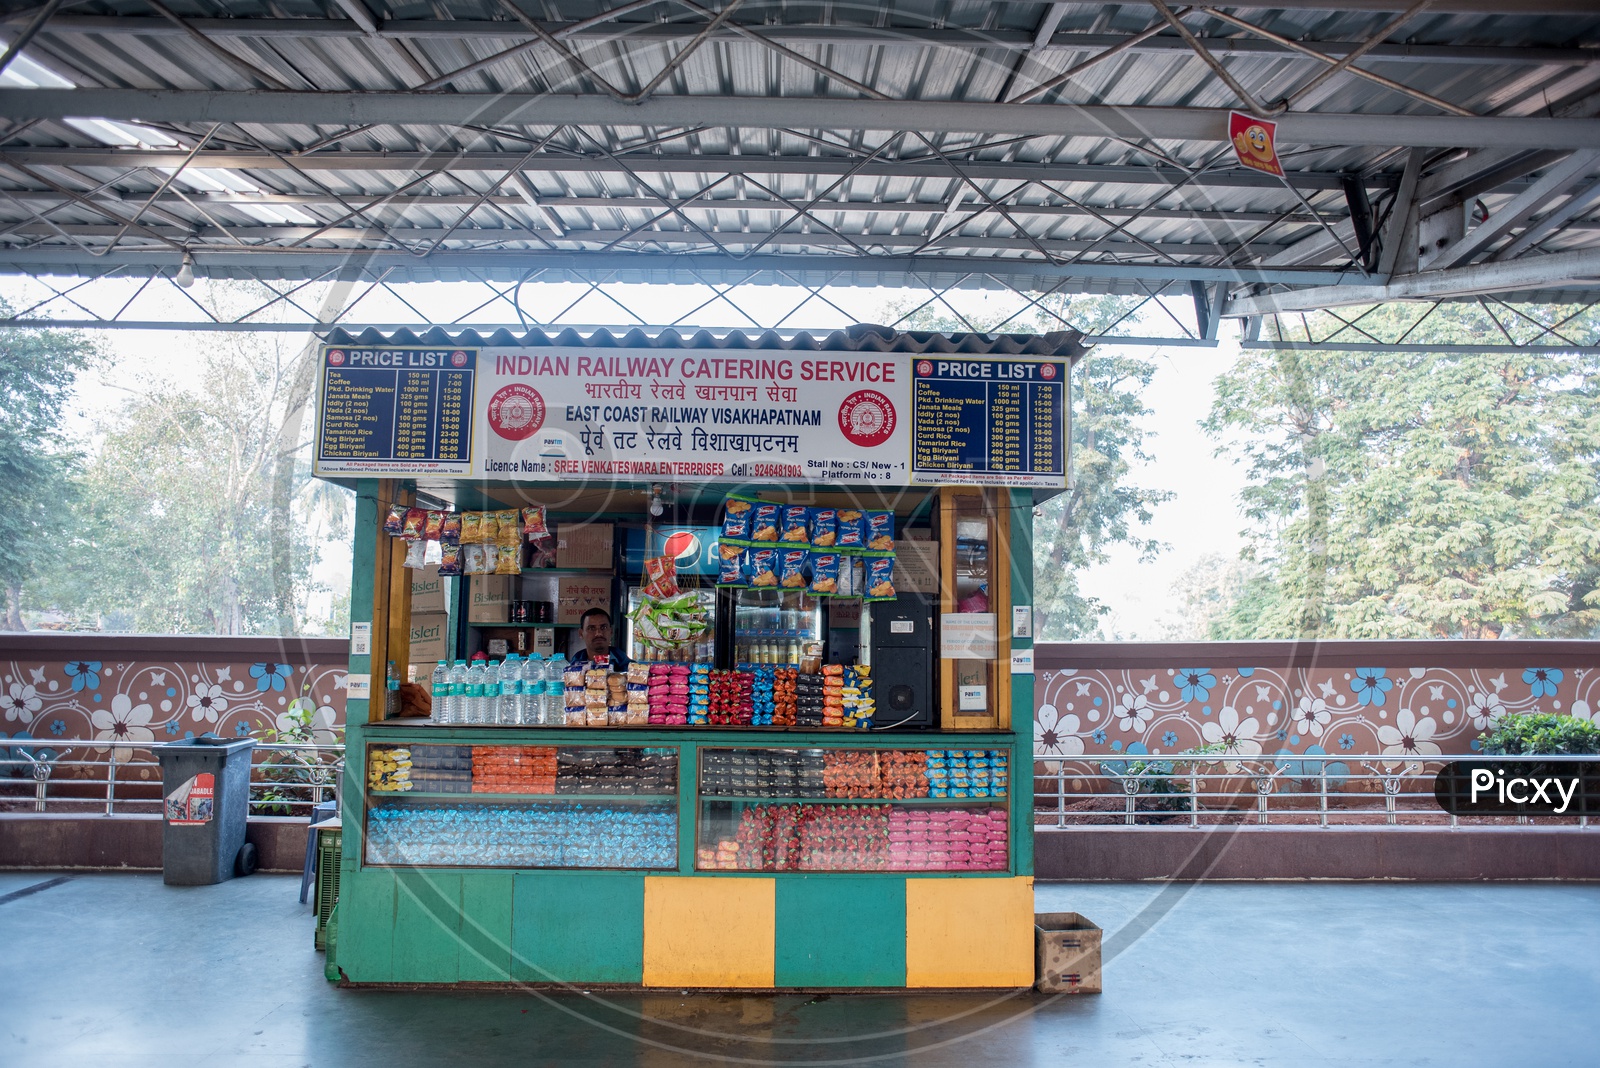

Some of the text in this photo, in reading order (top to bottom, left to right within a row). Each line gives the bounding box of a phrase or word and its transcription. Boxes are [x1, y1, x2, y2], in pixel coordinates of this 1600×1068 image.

[350, 352, 447, 366] PRICE LIST
[496, 356, 895, 382] INDIAN RAILWAY CATERING SERVICE
[938, 362, 1036, 378] PRICE LIST
[514, 386, 535, 398] INDIAN
[585, 378, 797, 402] भारतीय रेलवे खानपान सेवा
[566, 406, 821, 426] EAST COAST RAILWAY VISAKHAPATNAM
[864, 393, 893, 434] INDIAN RAILWAYS
[613, 432, 637, 449] तट
[646, 426, 682, 450] रेलवे
[692, 427, 799, 453] विशाखापटनम
[485, 460, 519, 472] Licence
[521, 460, 545, 473] Name
[554, 460, 578, 473] SREE
[581, 461, 657, 474] VENKATESWARA
[660, 462, 724, 476] ENTERPRISES
[732, 464, 747, 476] Cell
[754, 464, 802, 477] 9246481903
[822, 471, 861, 479] Platform
[566, 585, 579, 594] नीचे
[580, 585, 590, 594] की
[474, 592, 504, 603] Bisleri
[410, 624, 440, 639] isleri
